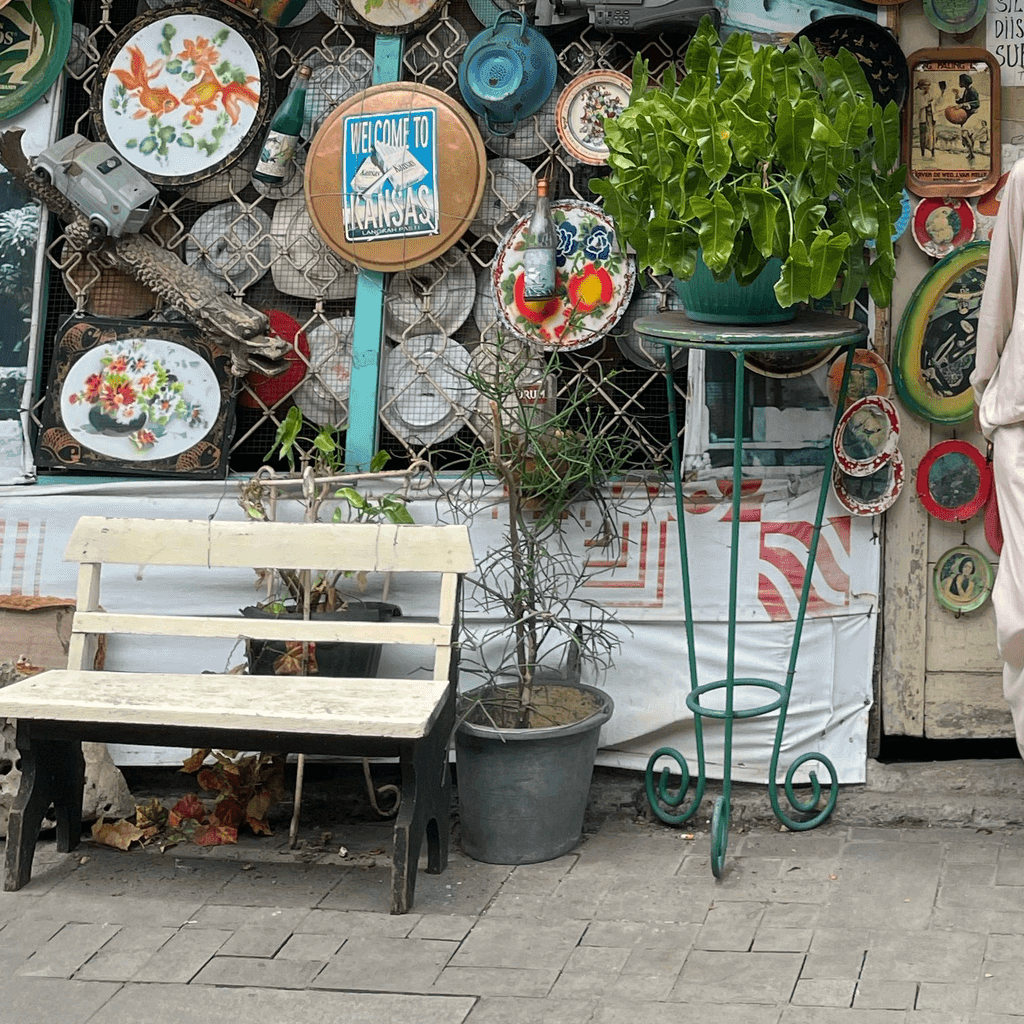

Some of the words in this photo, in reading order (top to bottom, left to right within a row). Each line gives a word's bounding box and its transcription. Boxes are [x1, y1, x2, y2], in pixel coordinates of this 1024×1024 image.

[350, 117, 411, 155] WELCOME
[413, 115, 429, 149] TO
[349, 184, 431, 231] KANSAS
[361, 226, 398, 237] LANGKAH
[398, 223, 422, 233] PASTI
